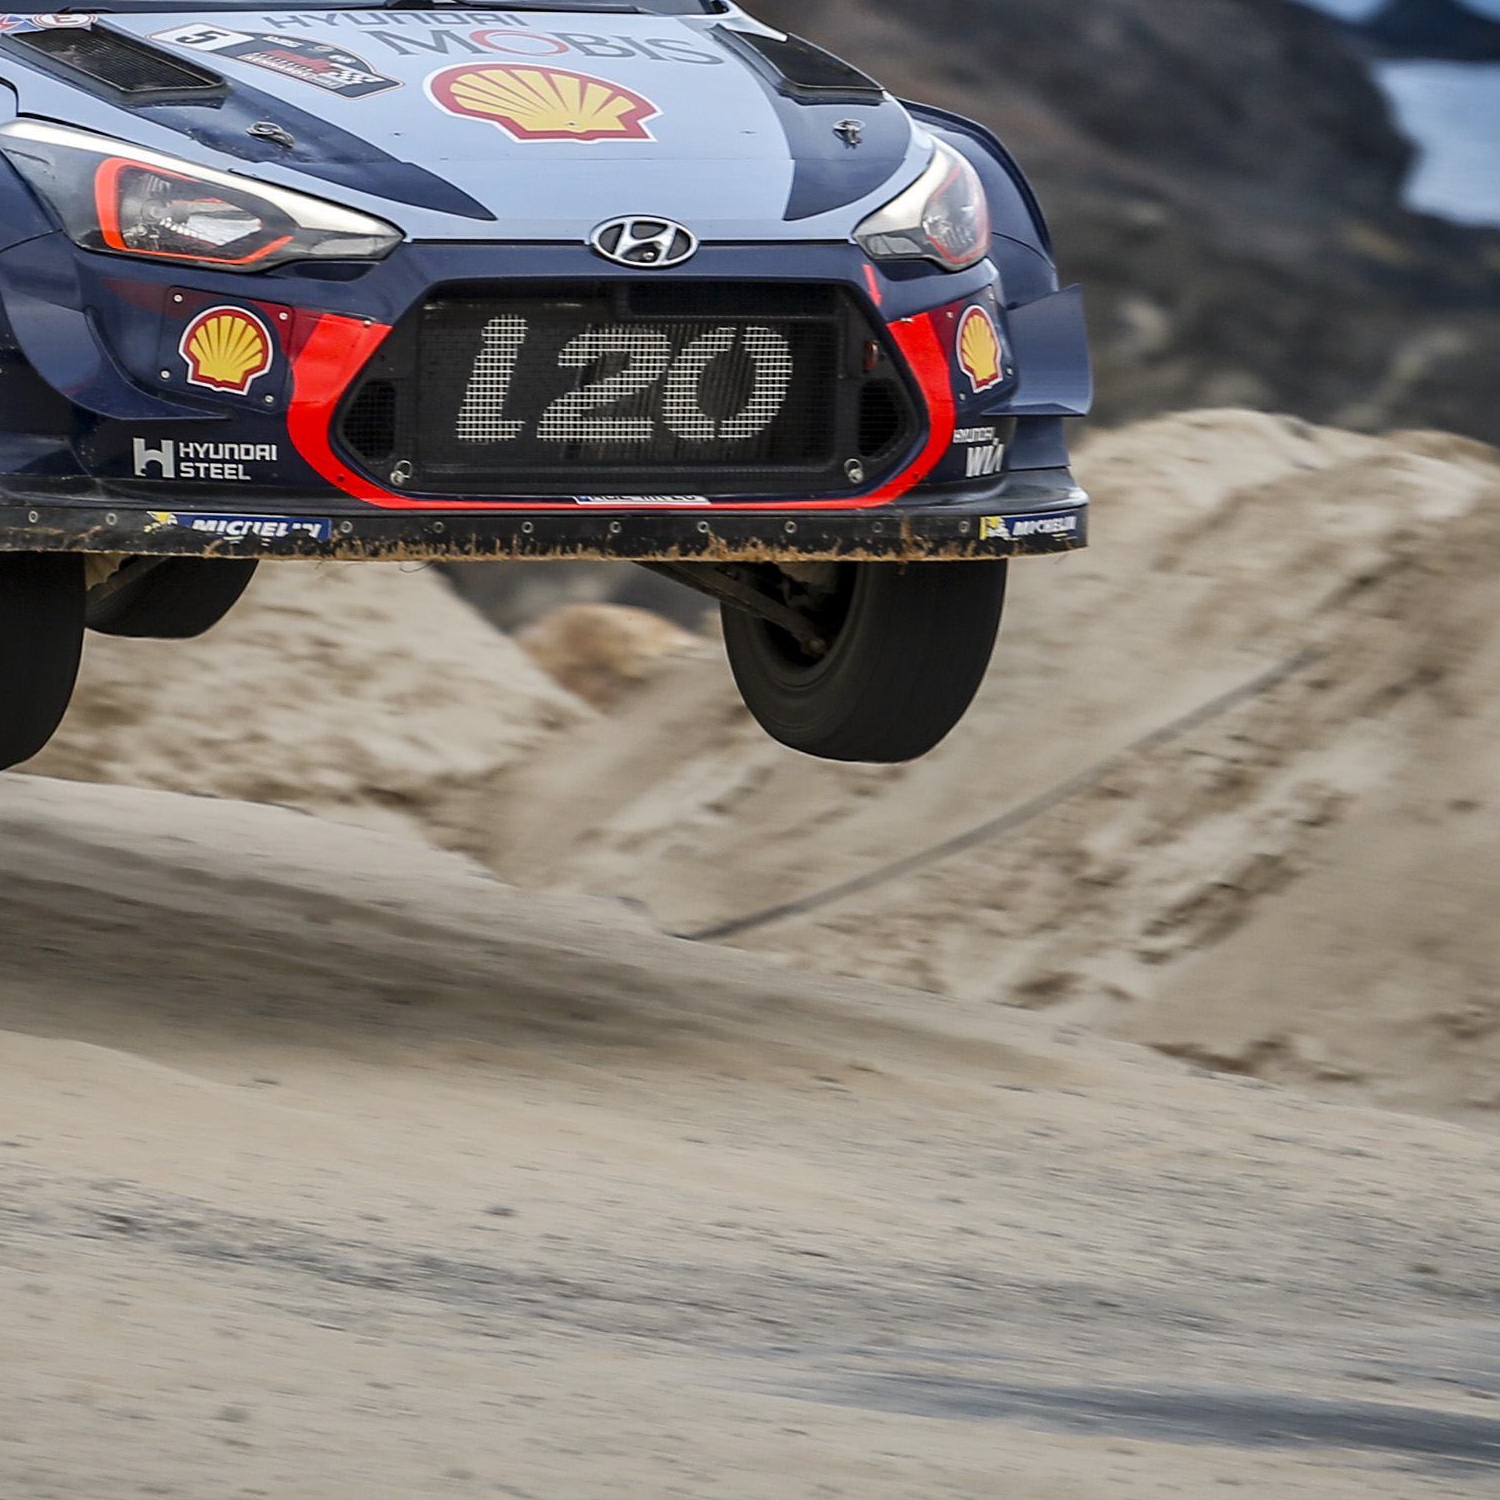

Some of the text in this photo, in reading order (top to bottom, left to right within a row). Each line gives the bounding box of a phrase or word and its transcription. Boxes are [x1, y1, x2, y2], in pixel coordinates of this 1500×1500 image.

[261, 11, 530, 30] HYUNDAI
[360, 28, 724, 65] MOBIS
[178, 442, 277, 461] HYUNDAI
[179, 462, 252, 481] STEEL
